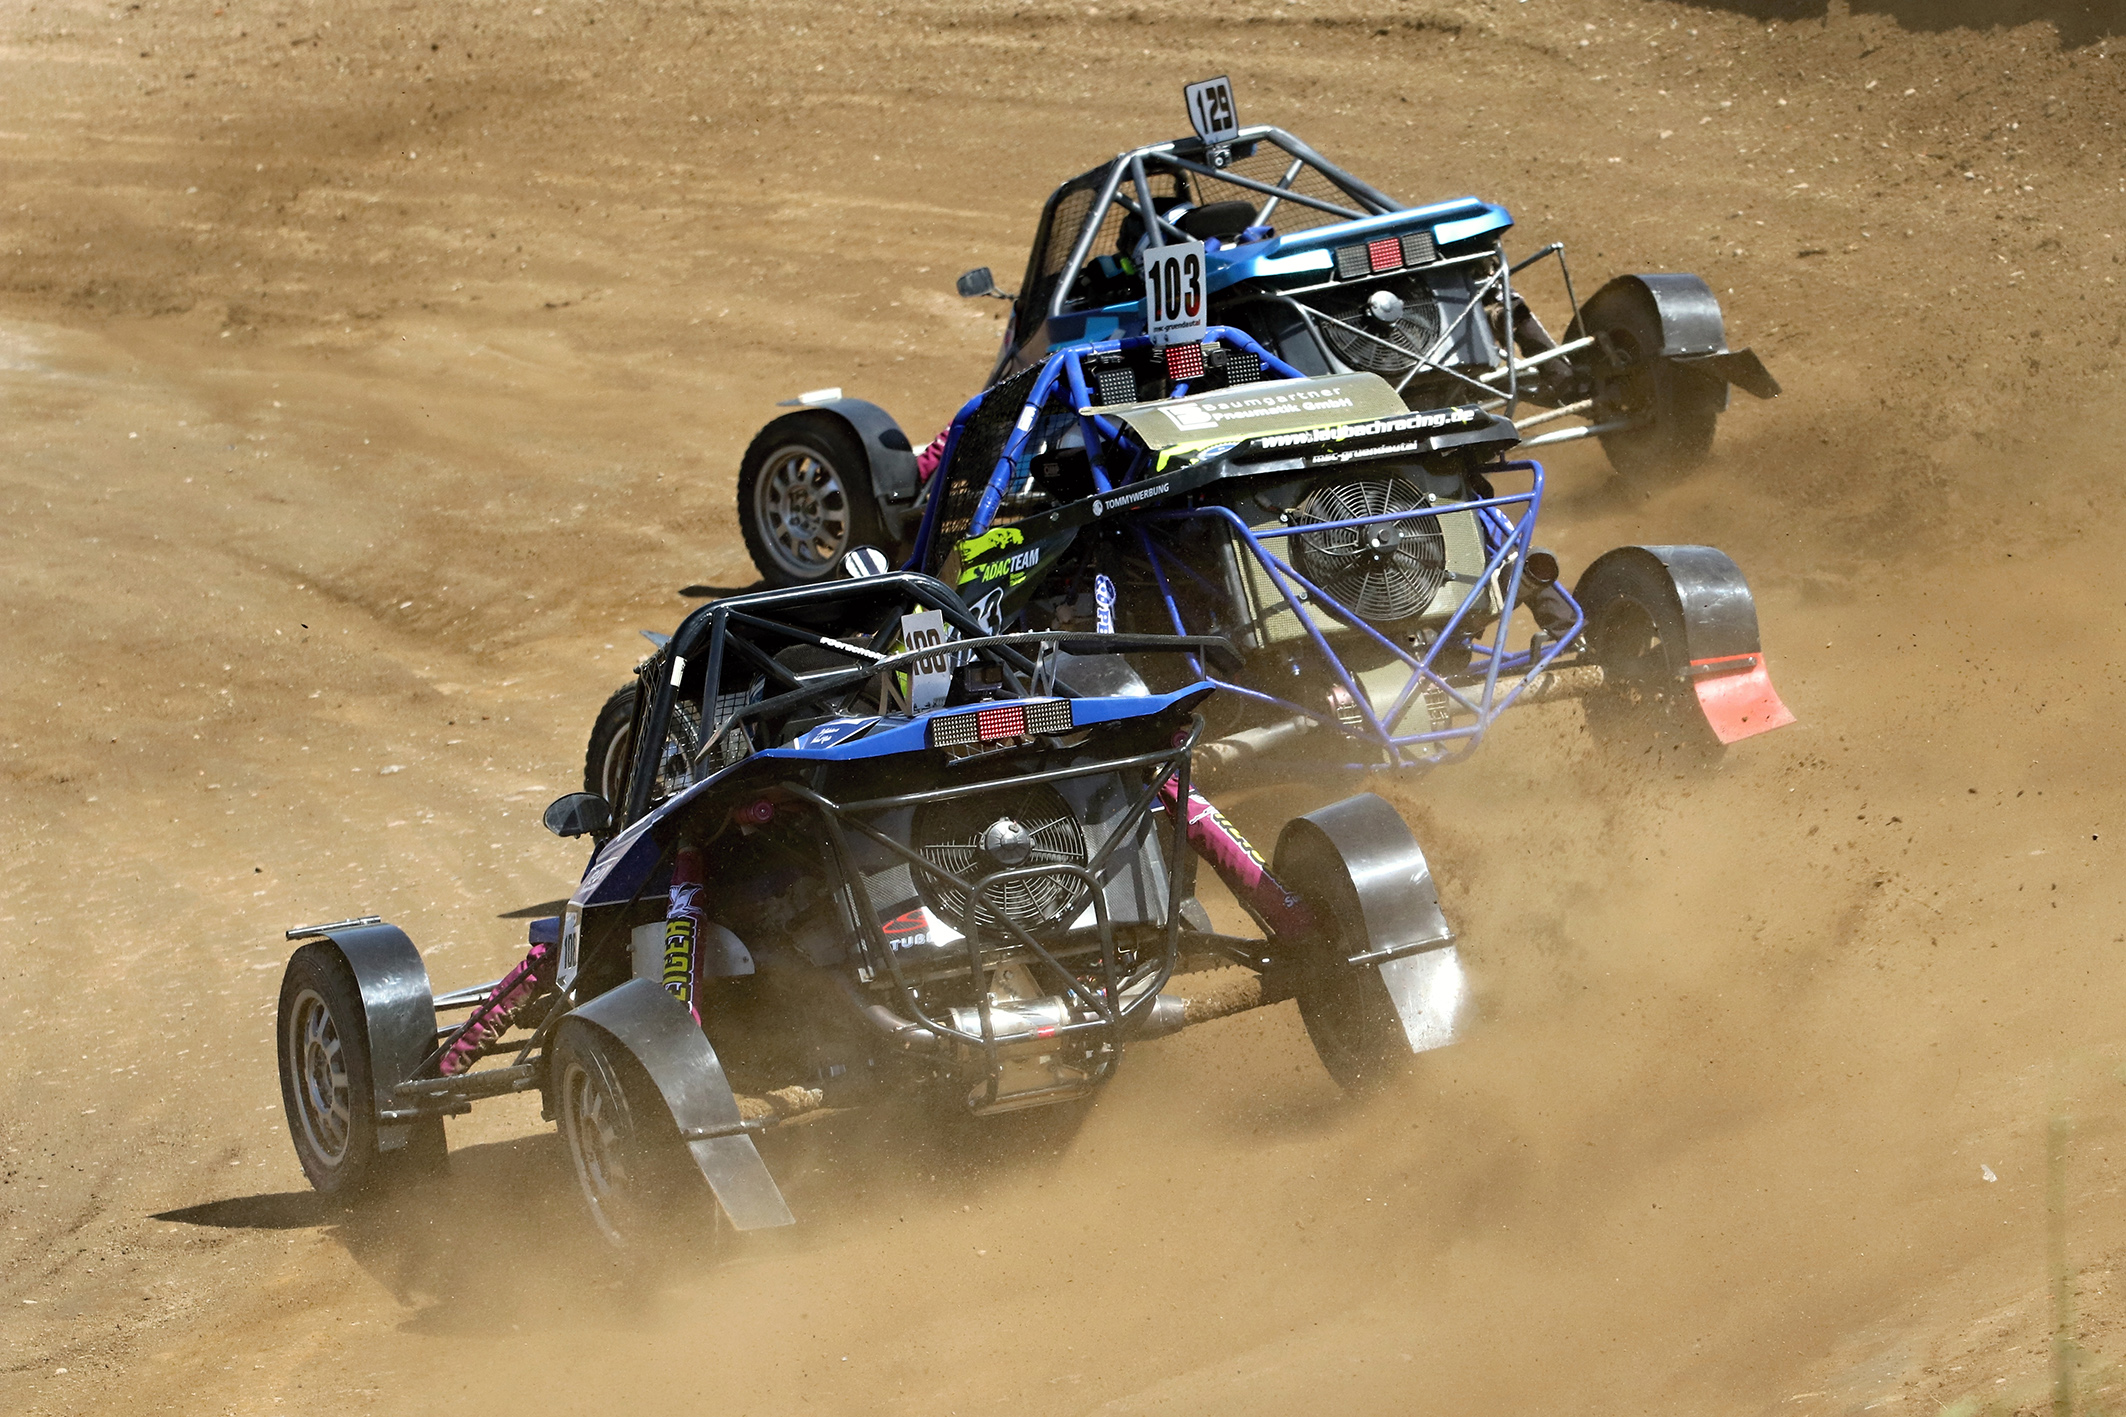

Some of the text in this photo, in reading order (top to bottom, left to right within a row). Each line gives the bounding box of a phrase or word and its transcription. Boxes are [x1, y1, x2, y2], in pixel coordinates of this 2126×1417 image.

[1197, 85, 1232, 134] 129
[1149, 253, 1201, 321] 103
[1201, 387, 1340, 411] Baumgartner
[1211, 398, 1353, 421] Pneumatik GmbH
[1105, 482, 1170, 510] TOMMYWERBUNG
